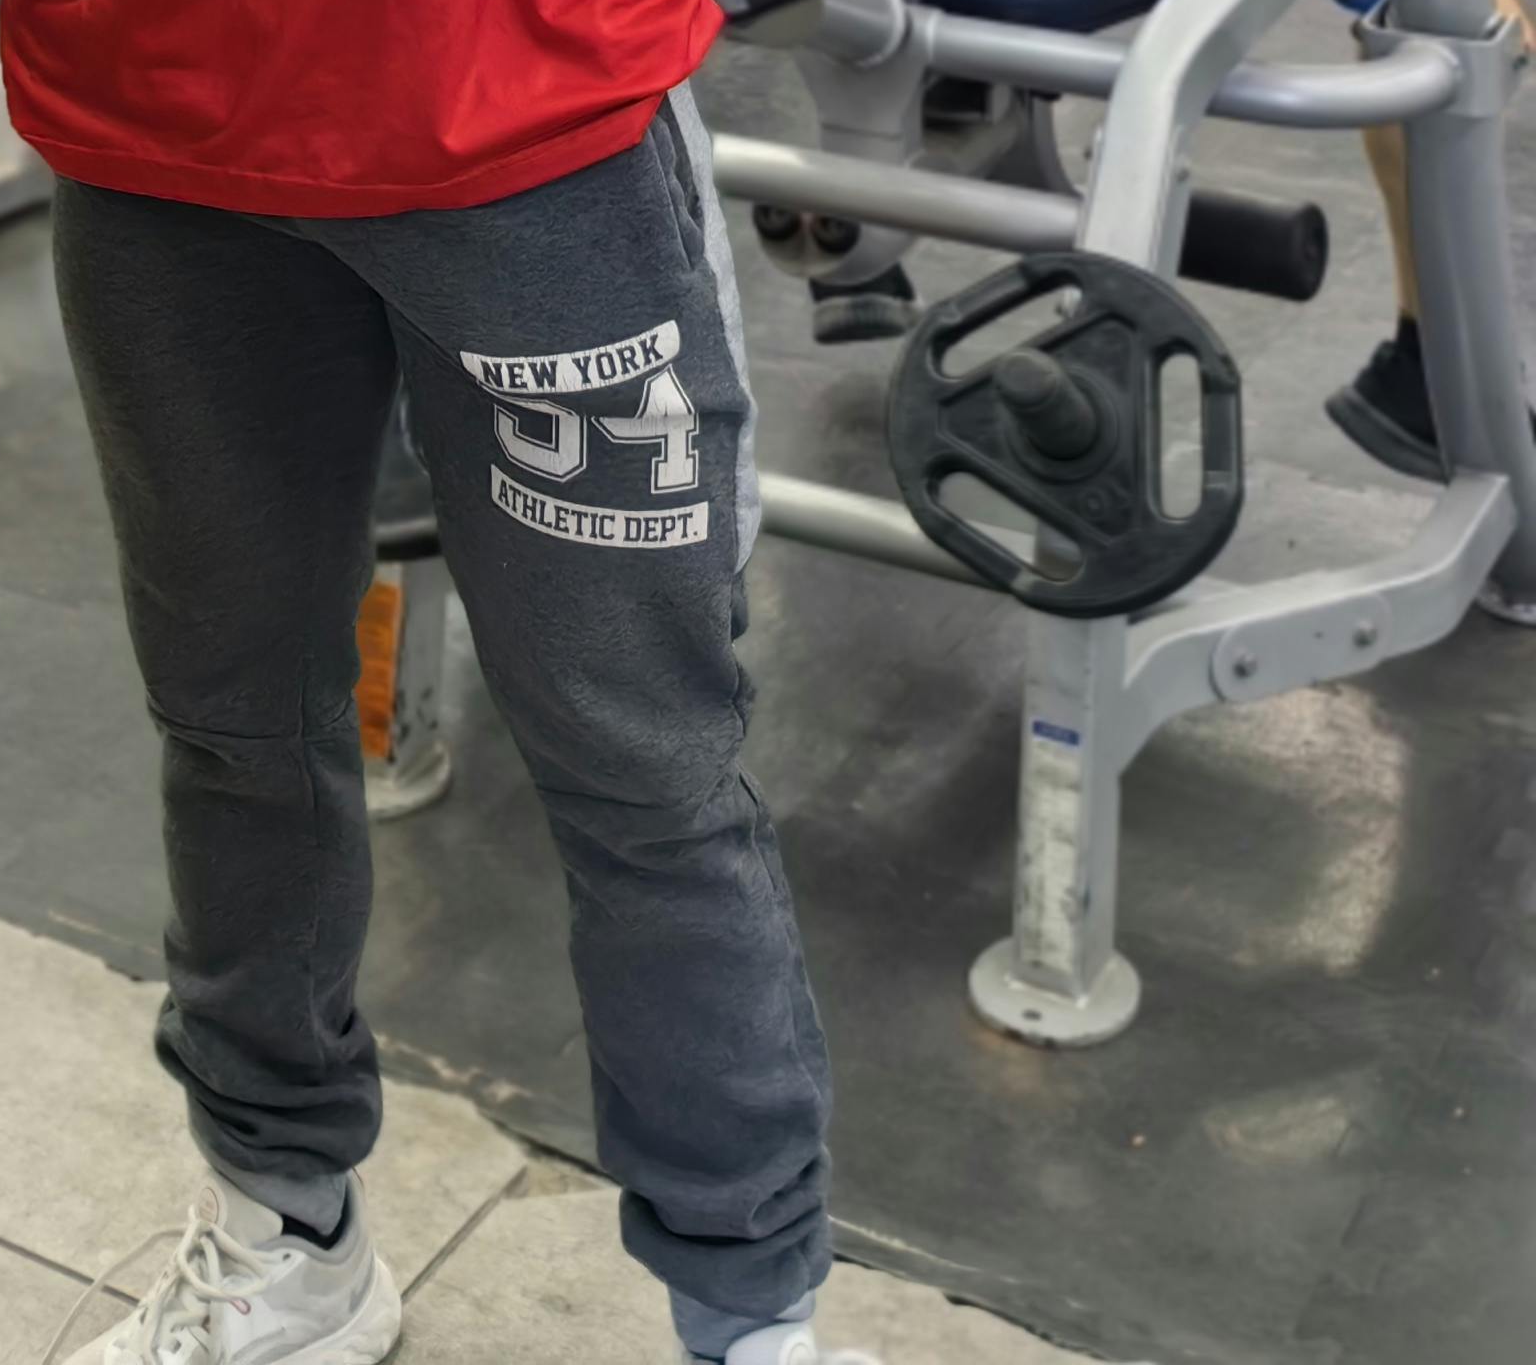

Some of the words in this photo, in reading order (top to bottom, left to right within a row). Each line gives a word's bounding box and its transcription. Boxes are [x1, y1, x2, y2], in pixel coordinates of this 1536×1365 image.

[479, 359, 558, 390] NEW
[571, 333, 664, 385] YORK
[496, 478, 617, 540] ATHLETIC
[622, 511, 699, 543] DEPT.
